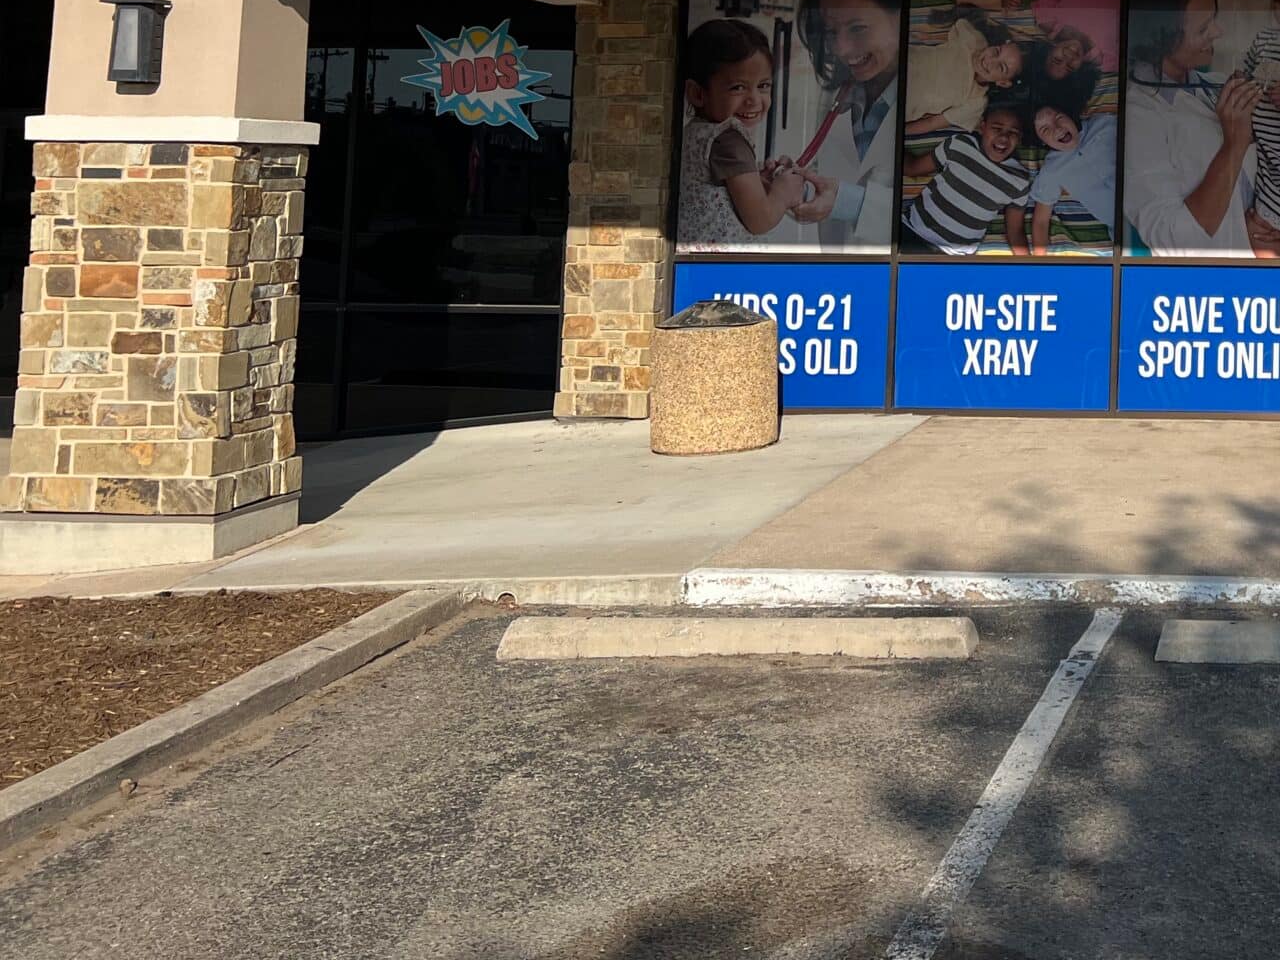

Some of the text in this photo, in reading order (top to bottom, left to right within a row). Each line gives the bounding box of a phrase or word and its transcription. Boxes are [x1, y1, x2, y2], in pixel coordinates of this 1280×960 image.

[440, 53, 519, 98] JOBS
[785, 293, 852, 331] 0-21
[945, 293, 1058, 332] ON-SITE
[1152, 295, 1225, 334] SAVE
[804, 337, 858, 376] OLD
[961, 338, 1039, 376] XRAY
[1138, 340, 1211, 379] SPOT
